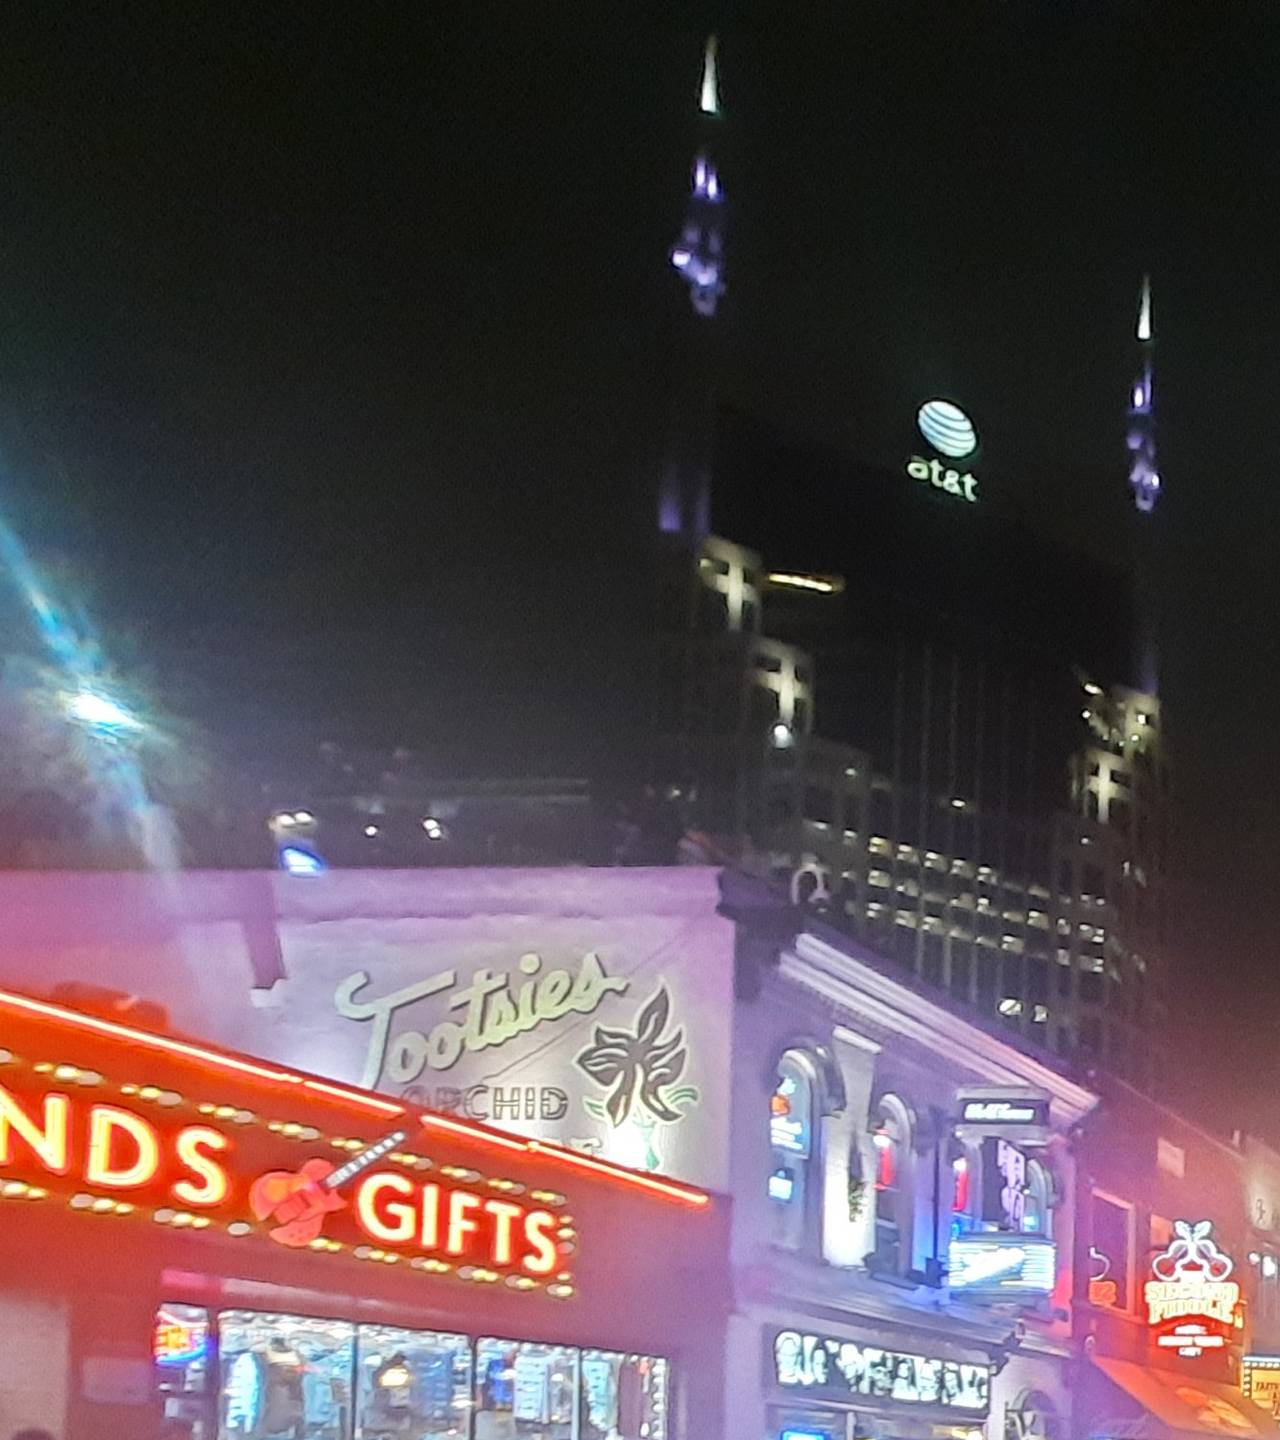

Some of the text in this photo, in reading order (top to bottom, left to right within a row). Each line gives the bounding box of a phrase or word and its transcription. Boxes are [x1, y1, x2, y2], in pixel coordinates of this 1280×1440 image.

[906, 455, 979, 502] at&t
[334, 951, 630, 1091] Tootsies
[401, 1083, 568, 1121] ORCHID
[356, 1170, 560, 1274] GIFTS
